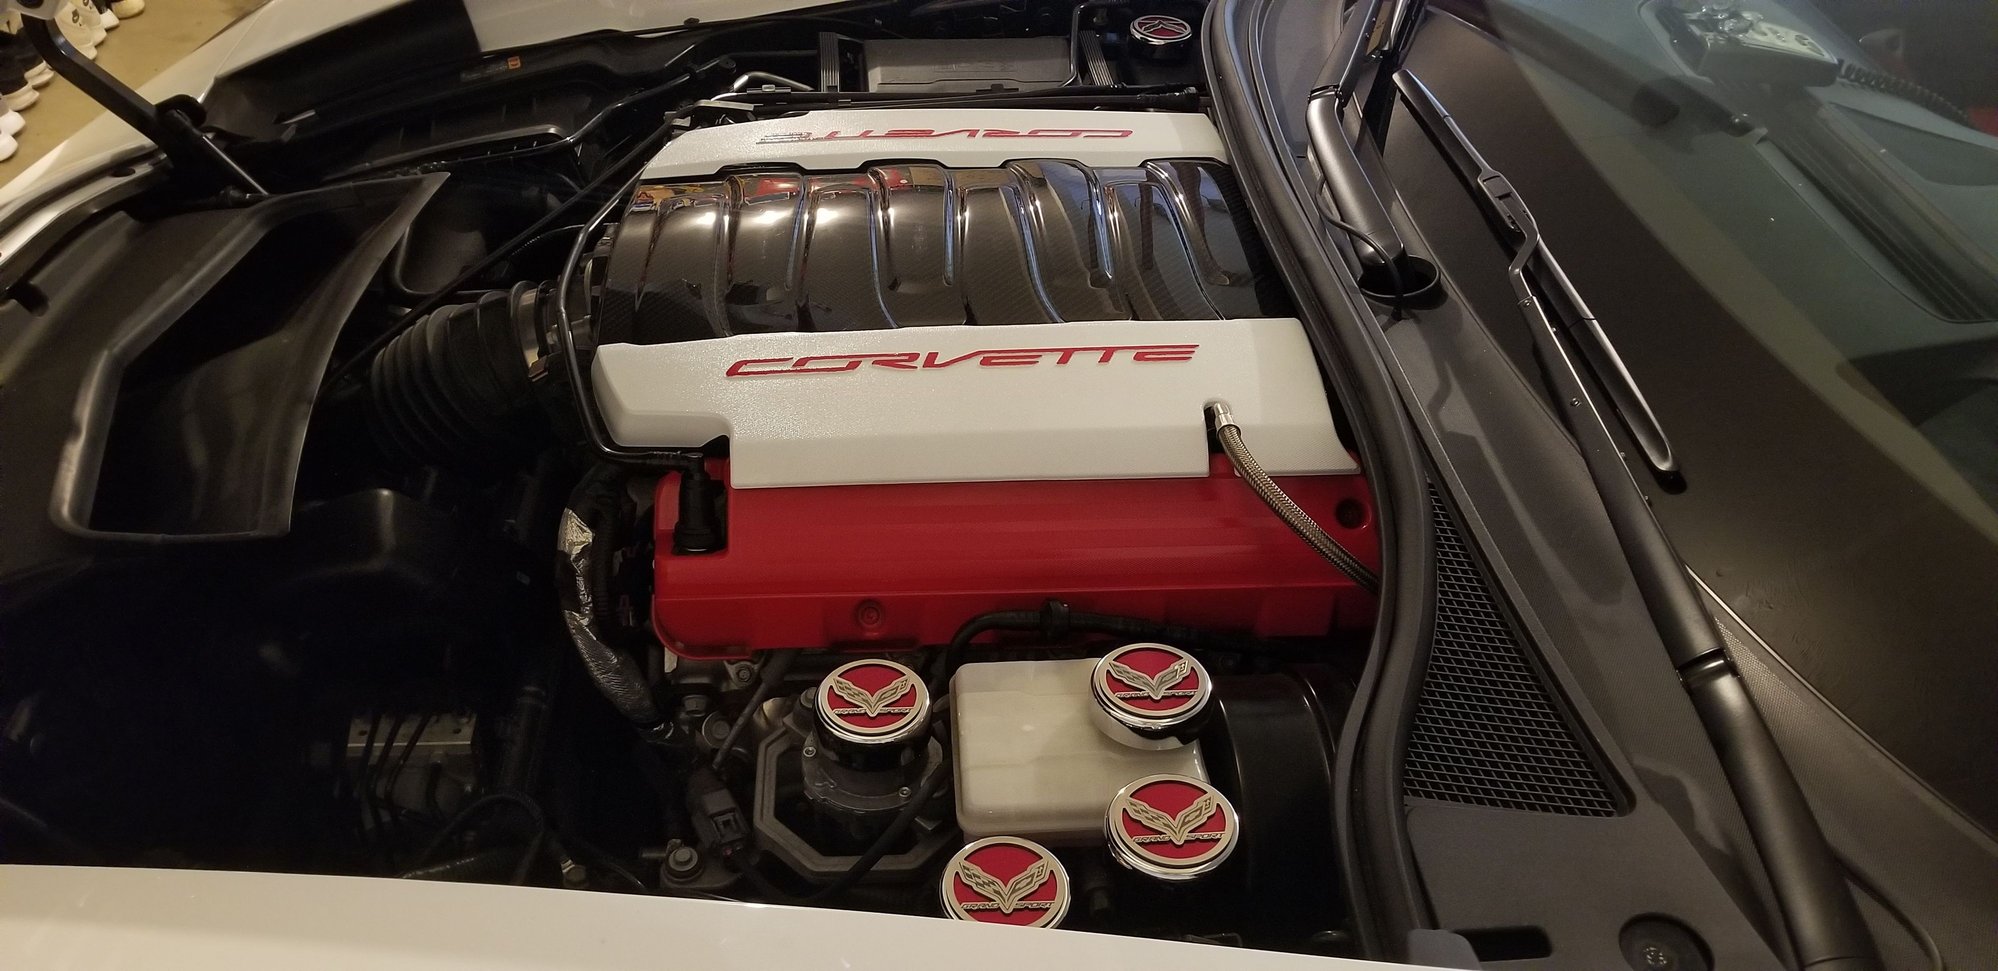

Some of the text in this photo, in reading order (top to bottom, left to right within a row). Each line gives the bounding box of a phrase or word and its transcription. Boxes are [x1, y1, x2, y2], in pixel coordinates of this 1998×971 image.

[755, 128, 1134, 145] CORVETTE
[725, 343, 1200, 378] CORVETTE
[1132, 832, 1225, 843] GRAND SPORT
[960, 902, 1000, 910] GRAND
